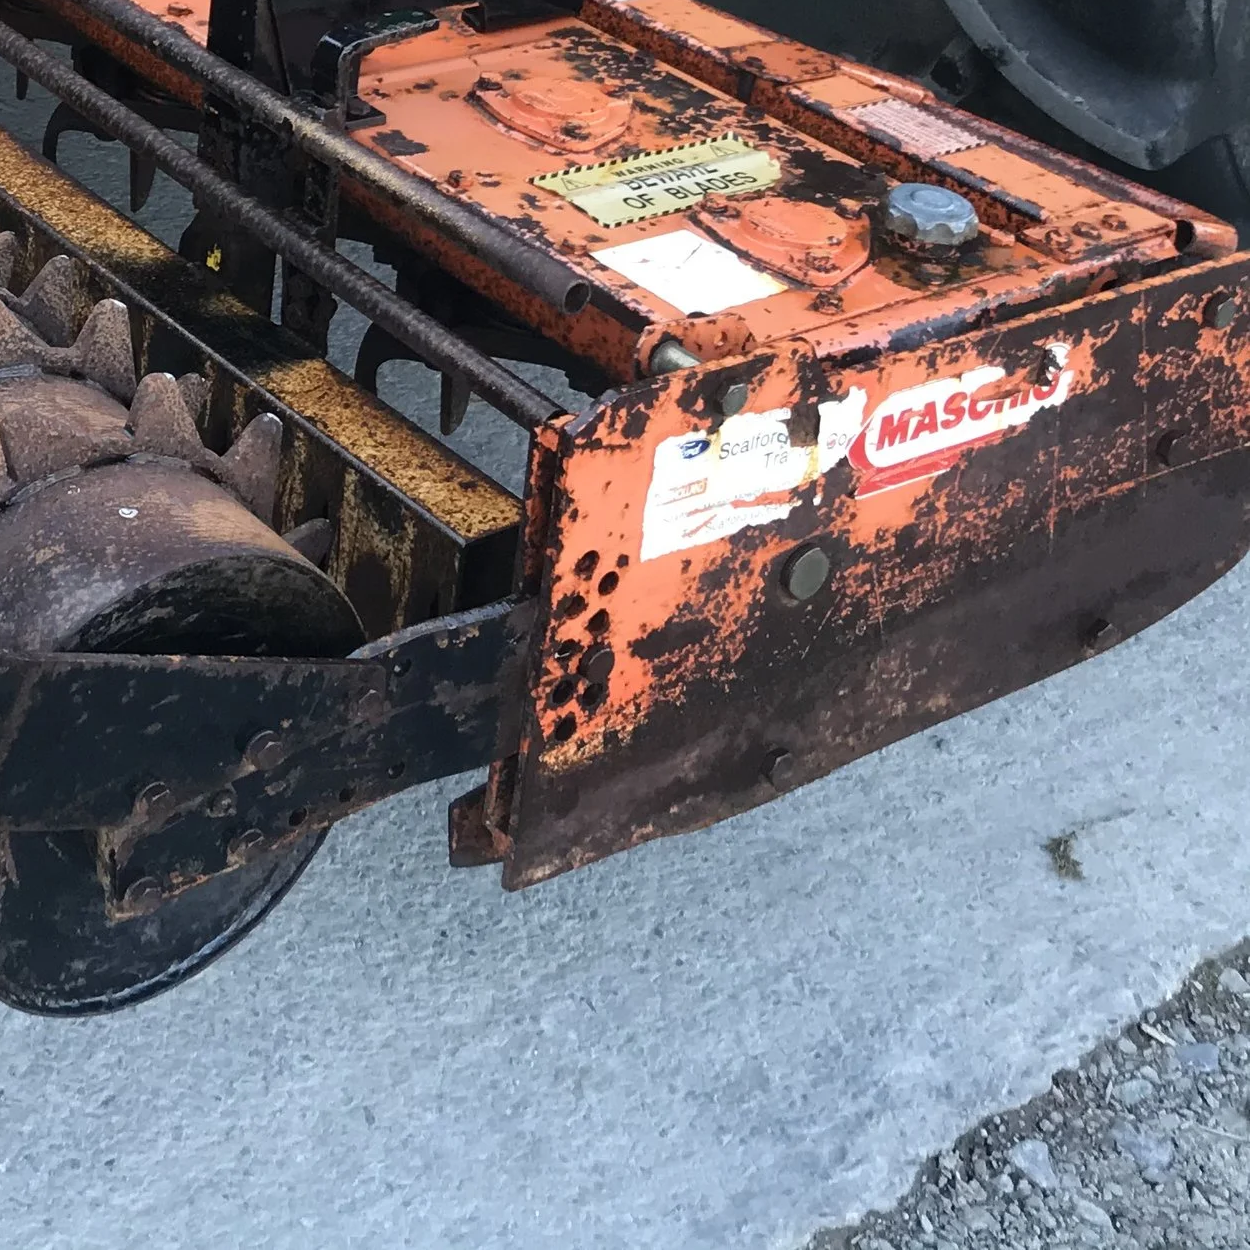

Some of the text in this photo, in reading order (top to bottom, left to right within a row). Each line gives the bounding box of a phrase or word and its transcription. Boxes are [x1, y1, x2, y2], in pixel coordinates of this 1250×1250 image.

[611, 157, 686, 178] WARNING
[621, 162, 718, 191] BEWARE
[664, 171, 758, 200] BLADES
[623, 193, 656, 210] OF
